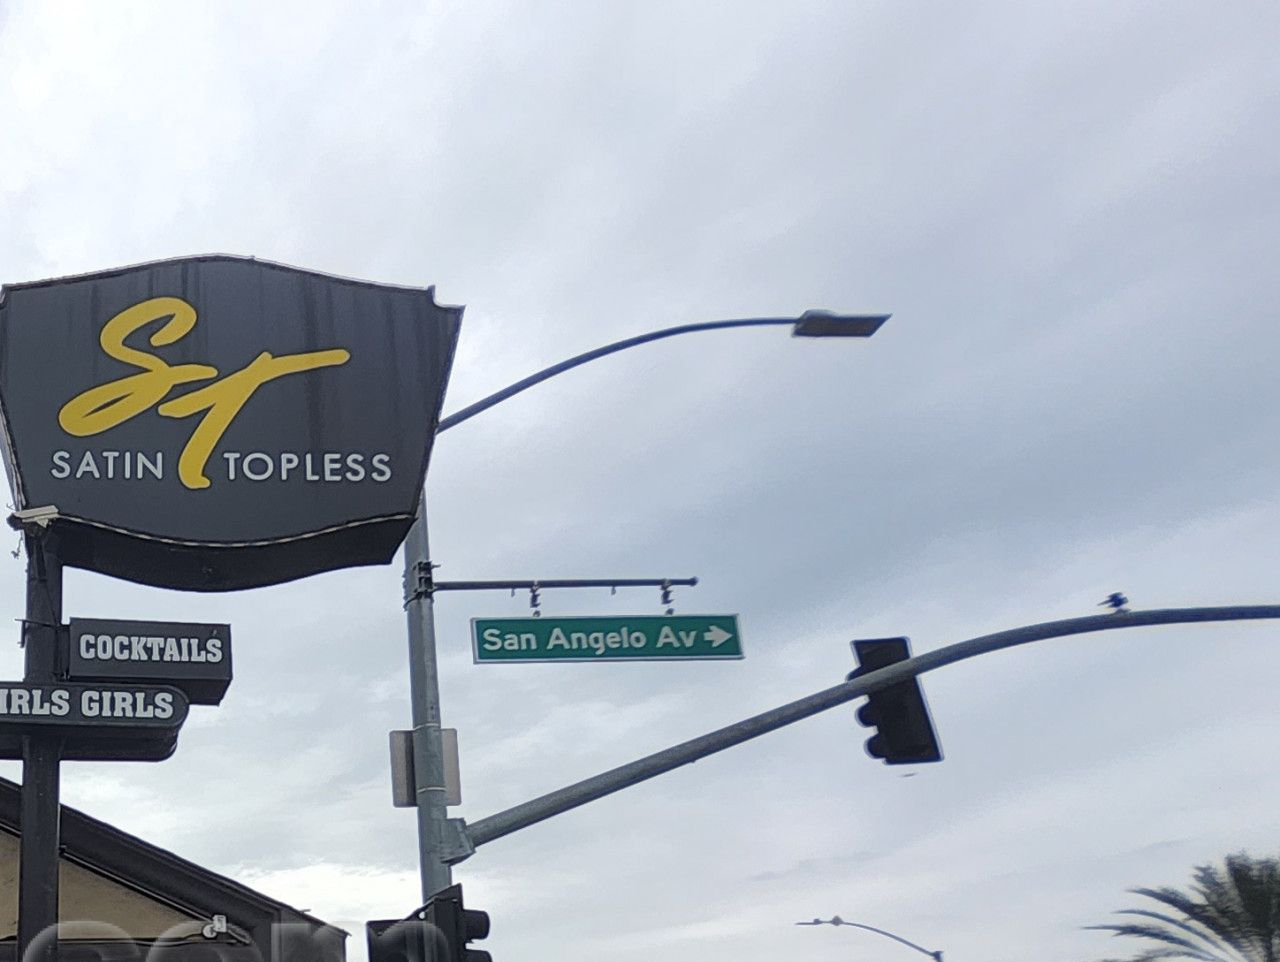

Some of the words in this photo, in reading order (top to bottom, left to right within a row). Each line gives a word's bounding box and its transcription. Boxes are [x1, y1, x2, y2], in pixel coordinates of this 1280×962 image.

[50, 450, 164, 481] SATIN
[223, 452, 392, 482] TOPLESS
[79, 633, 224, 663] COCKTAILS
[482, 628, 538, 651] San
[546, 626, 647, 655] Angelo
[655, 625, 698, 649] Av
[80, 688, 174, 719] GIRLS
